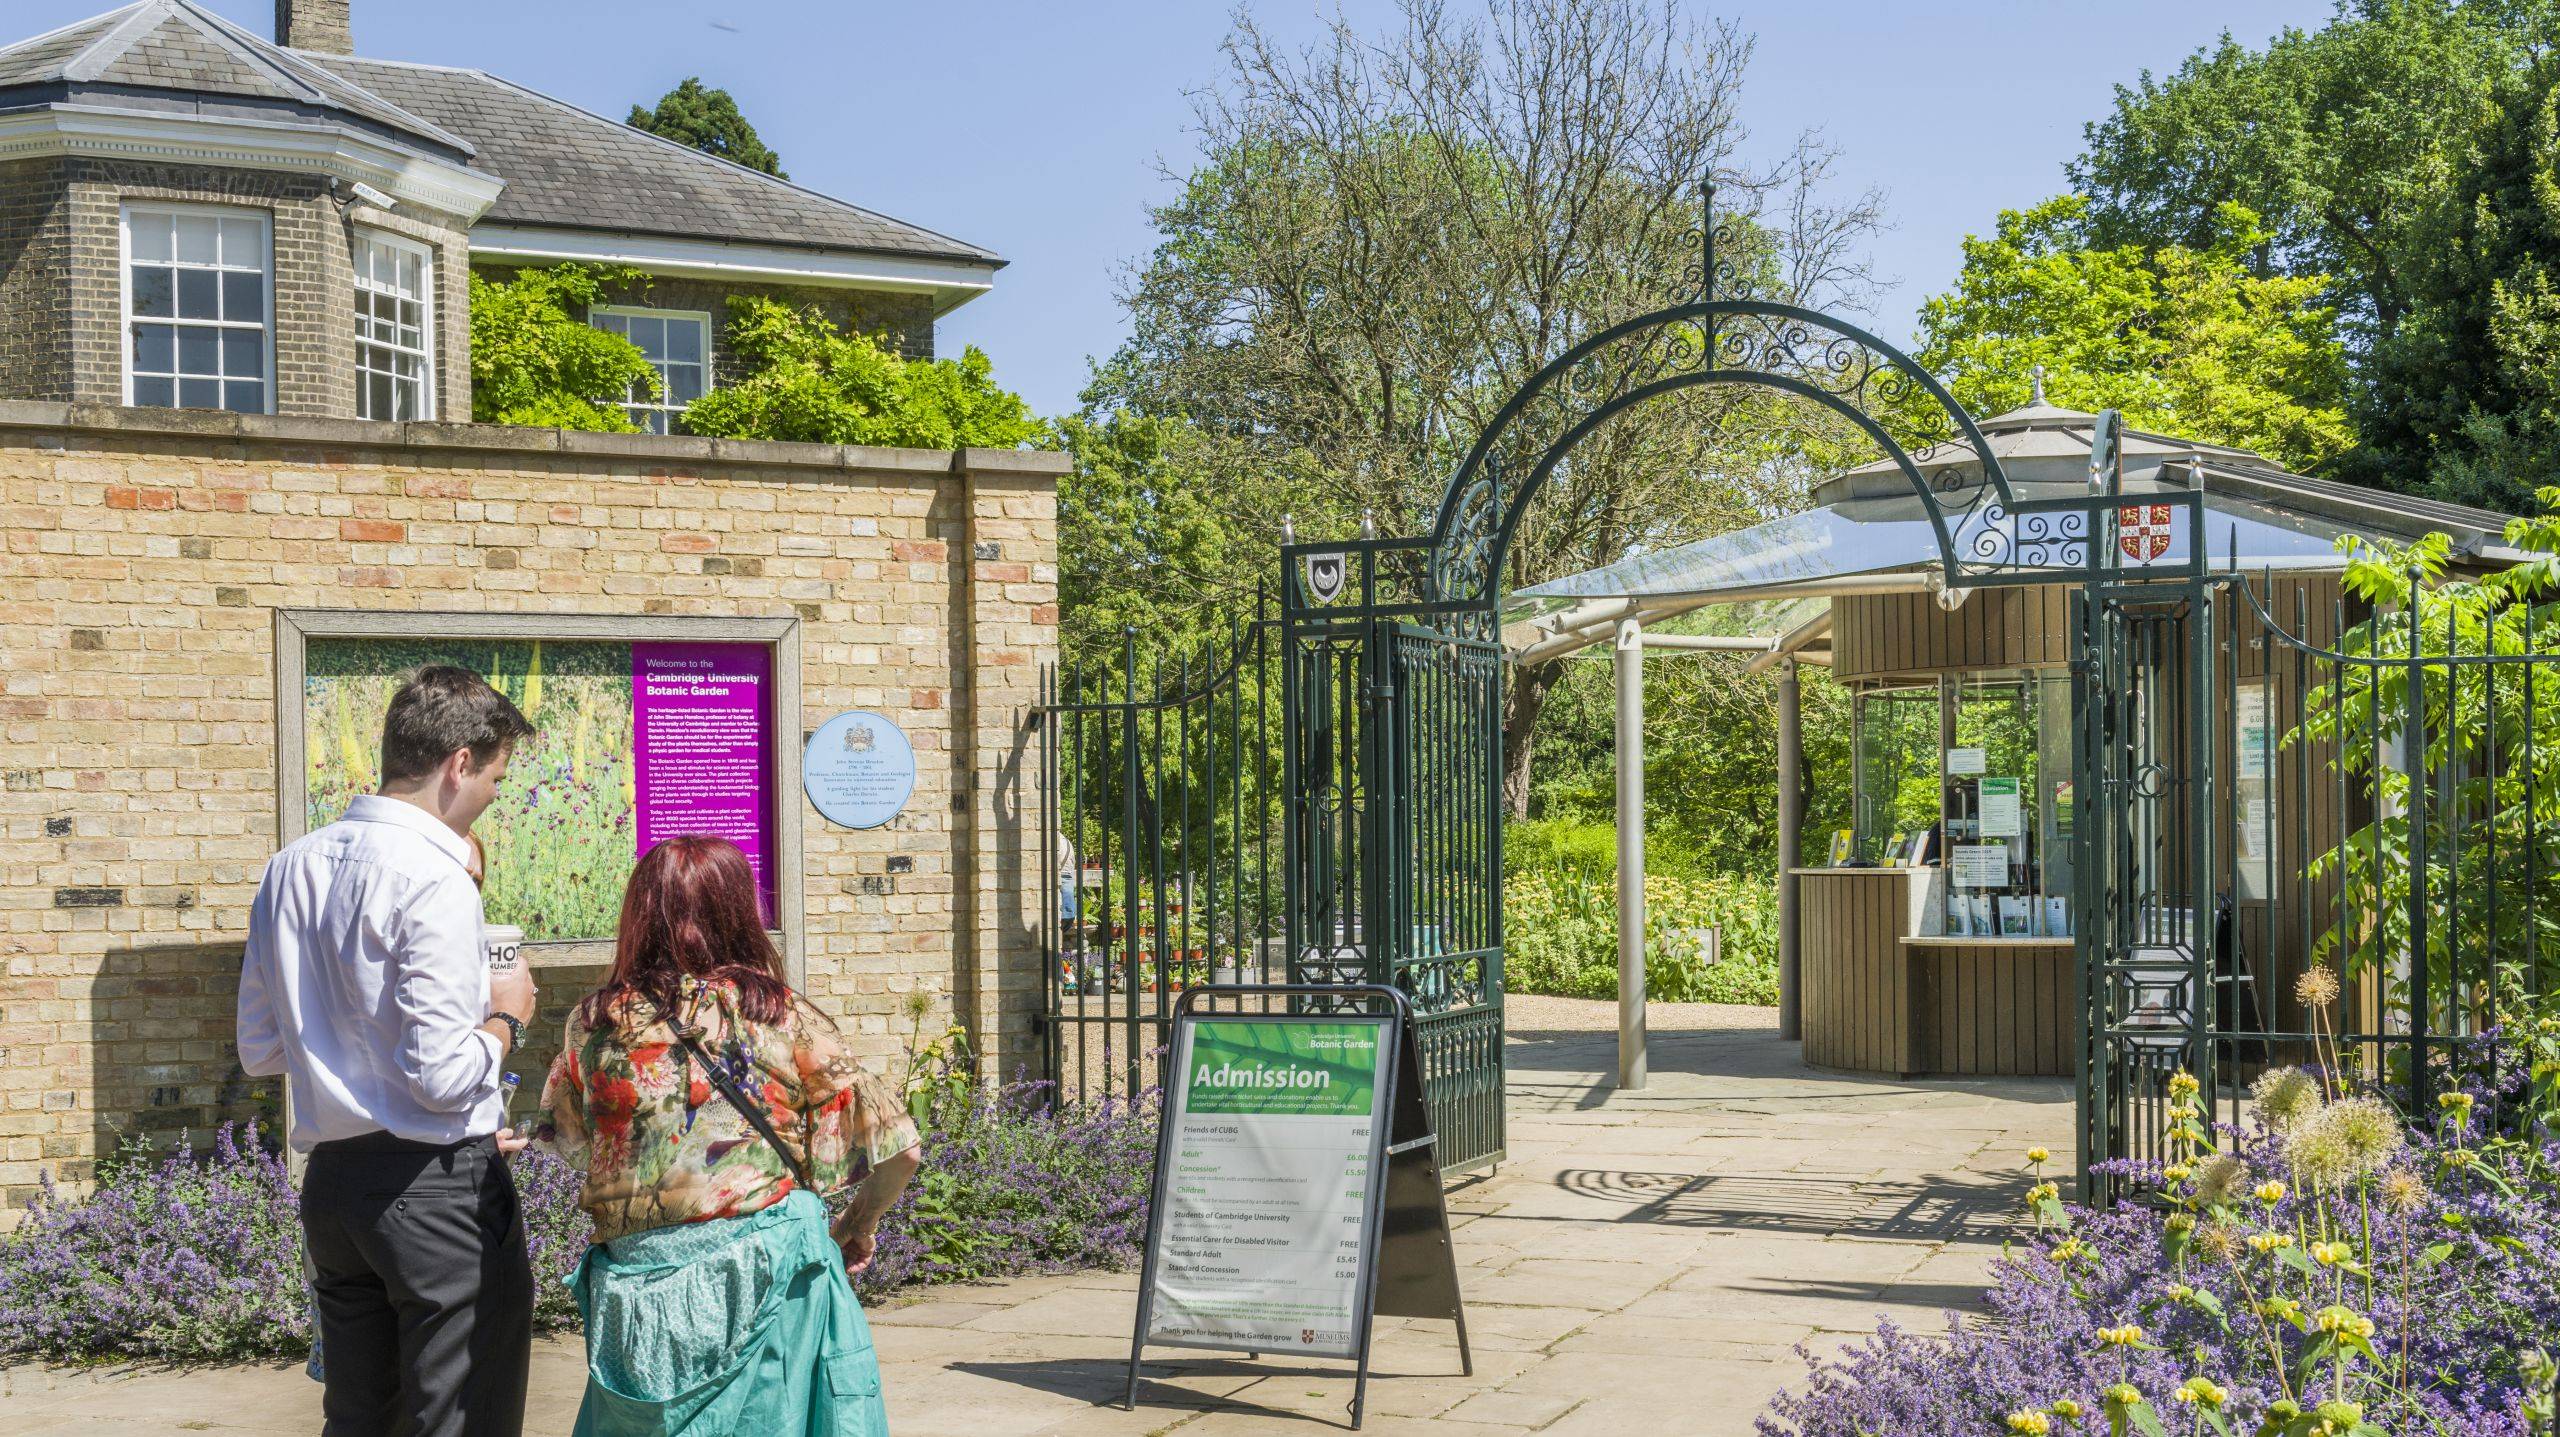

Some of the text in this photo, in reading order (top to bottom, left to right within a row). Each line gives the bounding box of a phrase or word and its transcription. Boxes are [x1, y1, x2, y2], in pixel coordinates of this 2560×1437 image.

[646, 659, 714, 668] Welcome to the
[646, 673, 759, 684] Cambridge University
[647, 686, 729, 695] Botanic Garden
[1310, 1040, 1373, 1048] Botanic Garden
[1194, 1063, 1330, 1088] Admission
[1177, 1186, 1206, 1194] Children
[1215, 1212, 1253, 1221] Cambridge
[1254, 1213, 1290, 1223] University
[1222, 1236, 1233, 1244] for
[1235, 1237, 1265, 1245] Disabled
[1266, 1238, 1289, 1246] Visitor
[1202, 1250, 1221, 1258] Adult
[1168, 1264, 1239, 1274] Standard Concession
[1208, 1330, 1232, 1339] helping
[1247, 1332, 1272, 1340] Garden
